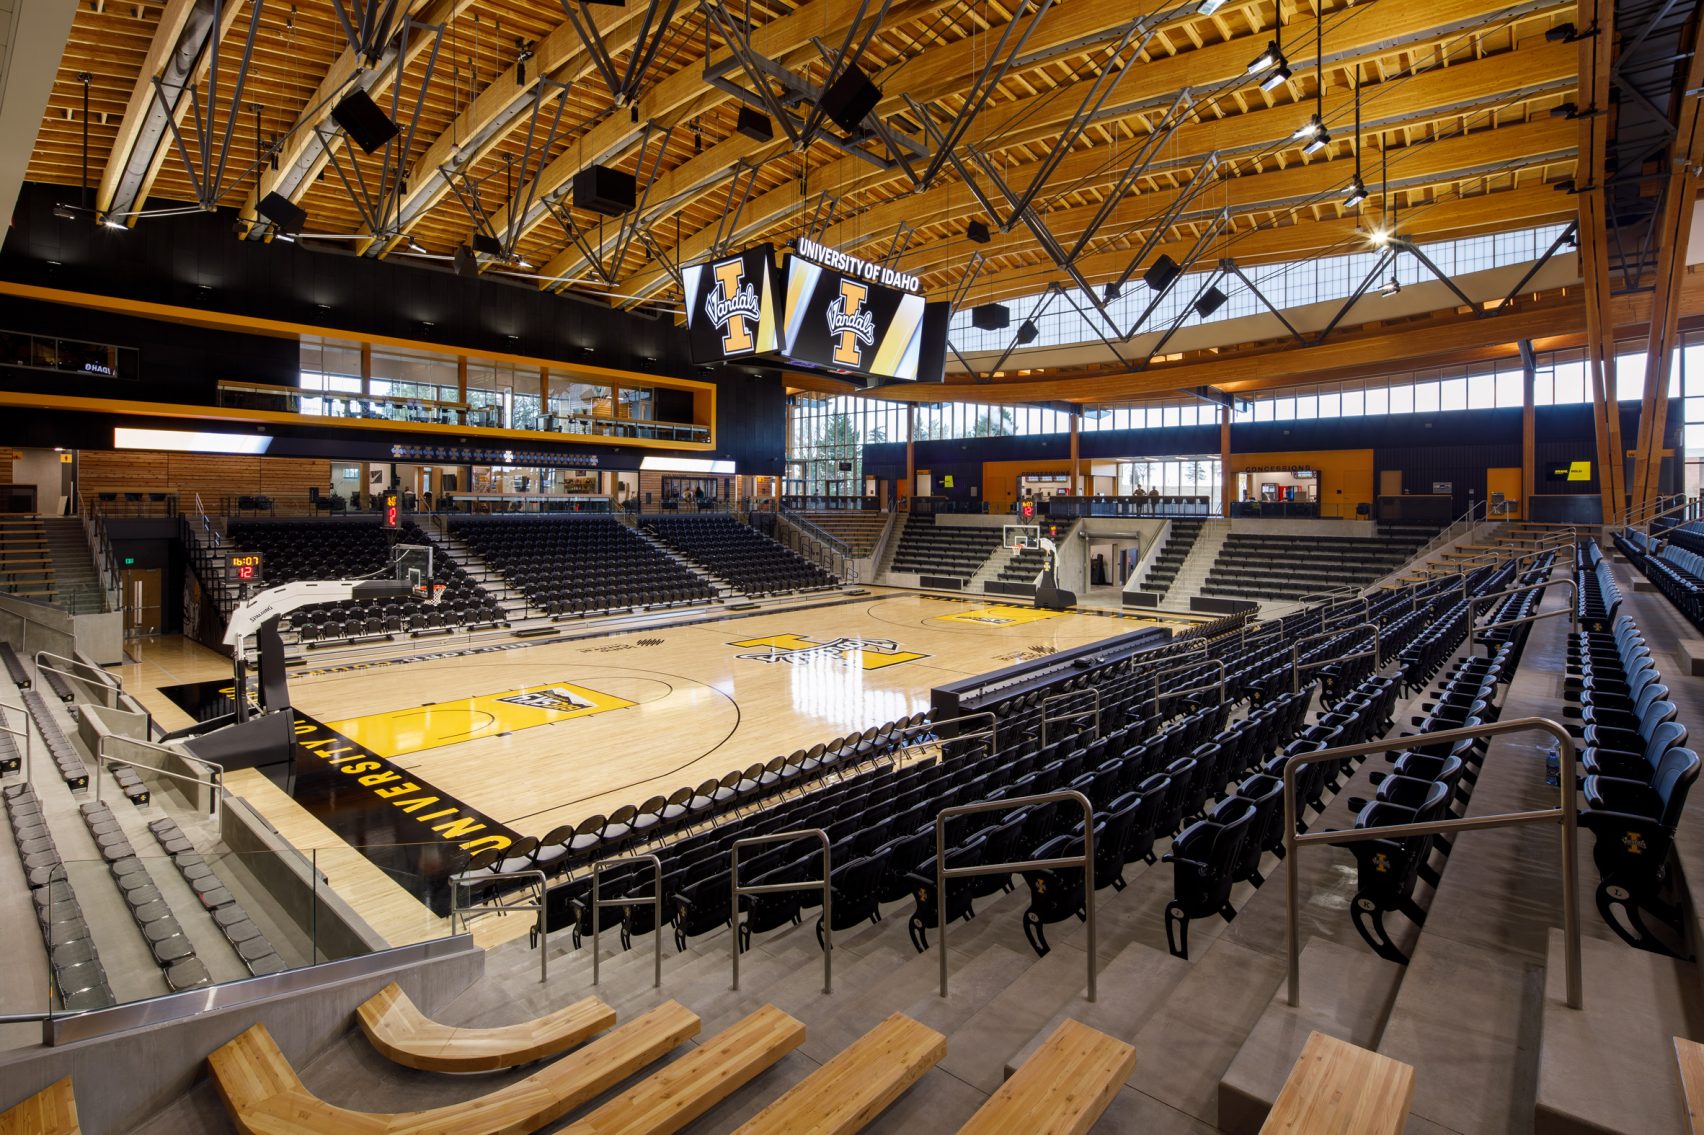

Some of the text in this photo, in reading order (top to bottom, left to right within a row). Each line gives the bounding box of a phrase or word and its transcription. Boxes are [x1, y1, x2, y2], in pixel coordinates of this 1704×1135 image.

[800, 238, 919, 292] UNIVERSITY OF IDAHO
[706, 284, 760, 328] Vandals
[827, 299, 874, 344] Vandals
[1245, 464, 1311, 473] CONCESSIONS
[233, 556, 259, 566] 16:07
[240, 566, 252, 578] 12
[299, 738, 512, 857] UNIVERSITY
